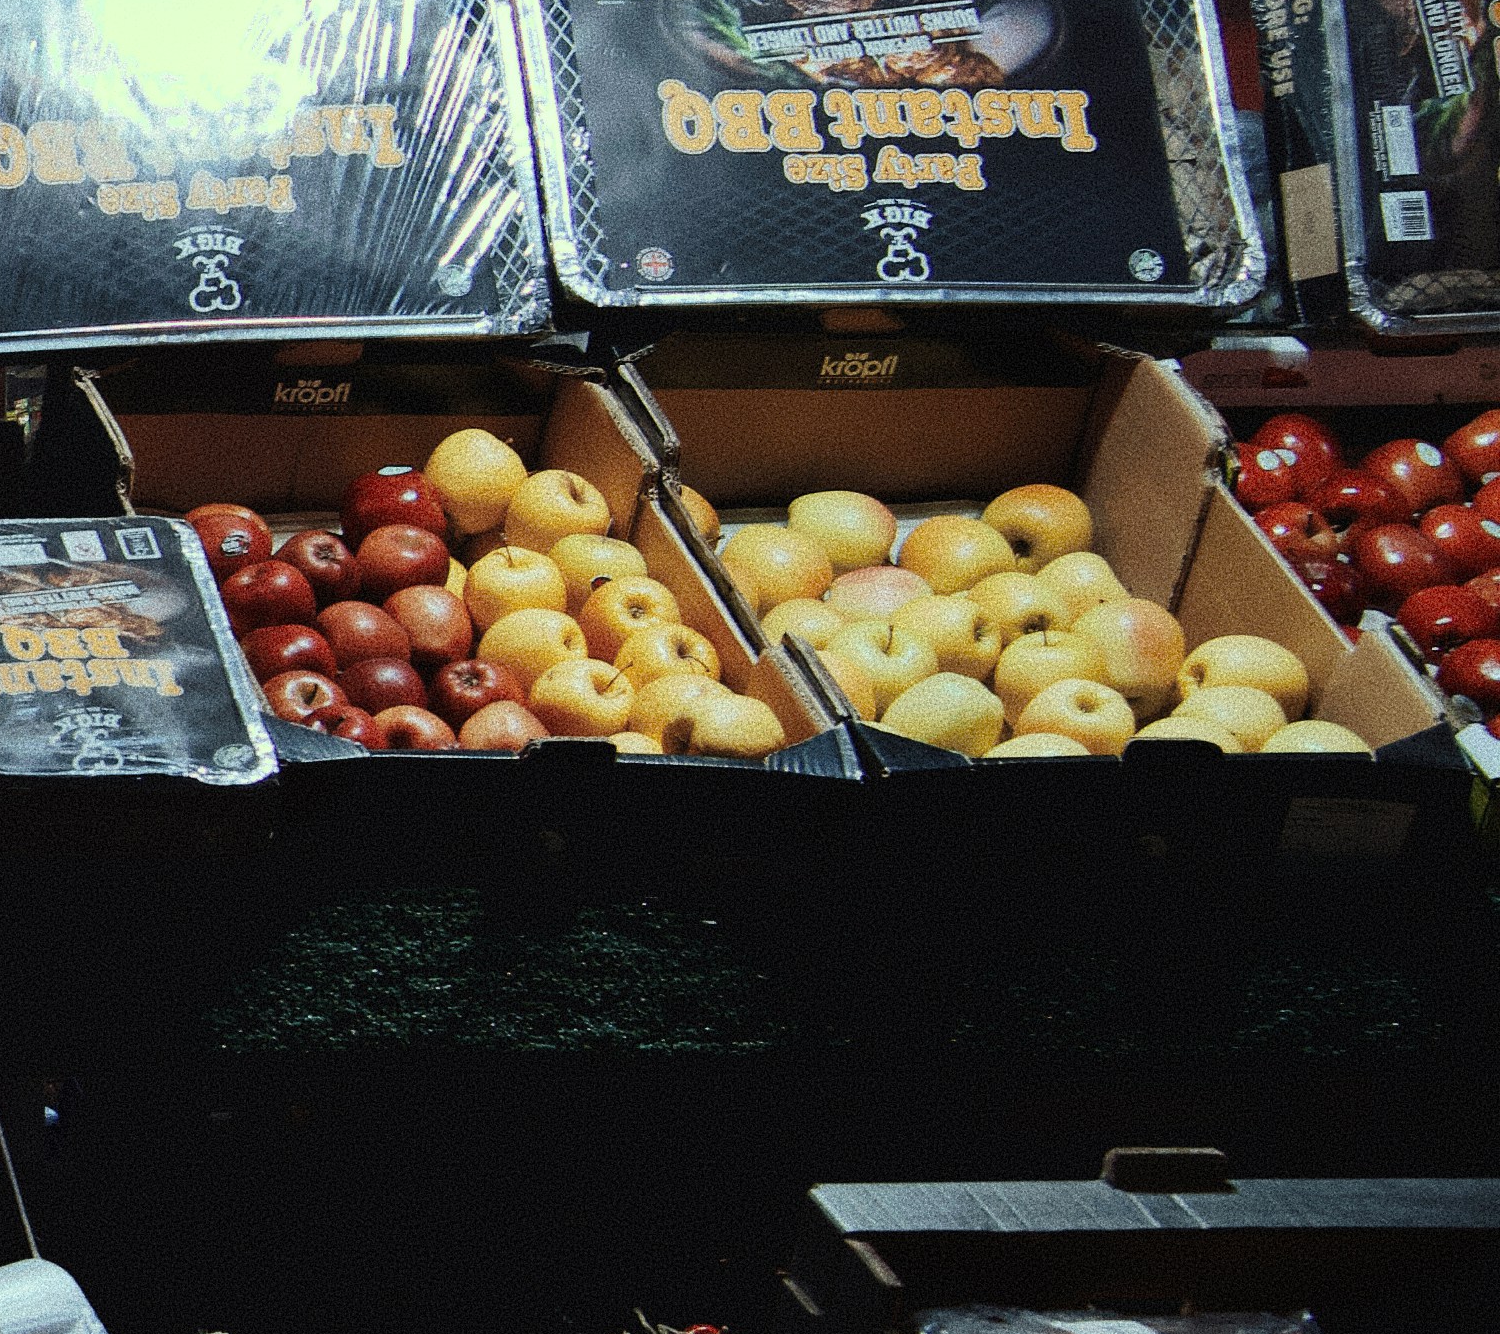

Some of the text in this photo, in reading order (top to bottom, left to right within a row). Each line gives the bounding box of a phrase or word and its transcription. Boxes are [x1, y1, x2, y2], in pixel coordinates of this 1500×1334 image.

[744, 23, 809, 49] LONGER
[812, 19, 849, 43] AND
[919, 7, 980, 32] BURNS
[1270, 51, 1296, 98] USE
[1425, 30, 1467, 97] LONGER
[656, 78, 1098, 155] Instant BBQ
[783, 147, 986, 191] Party Size
[97, 170, 296, 221] Party Size
